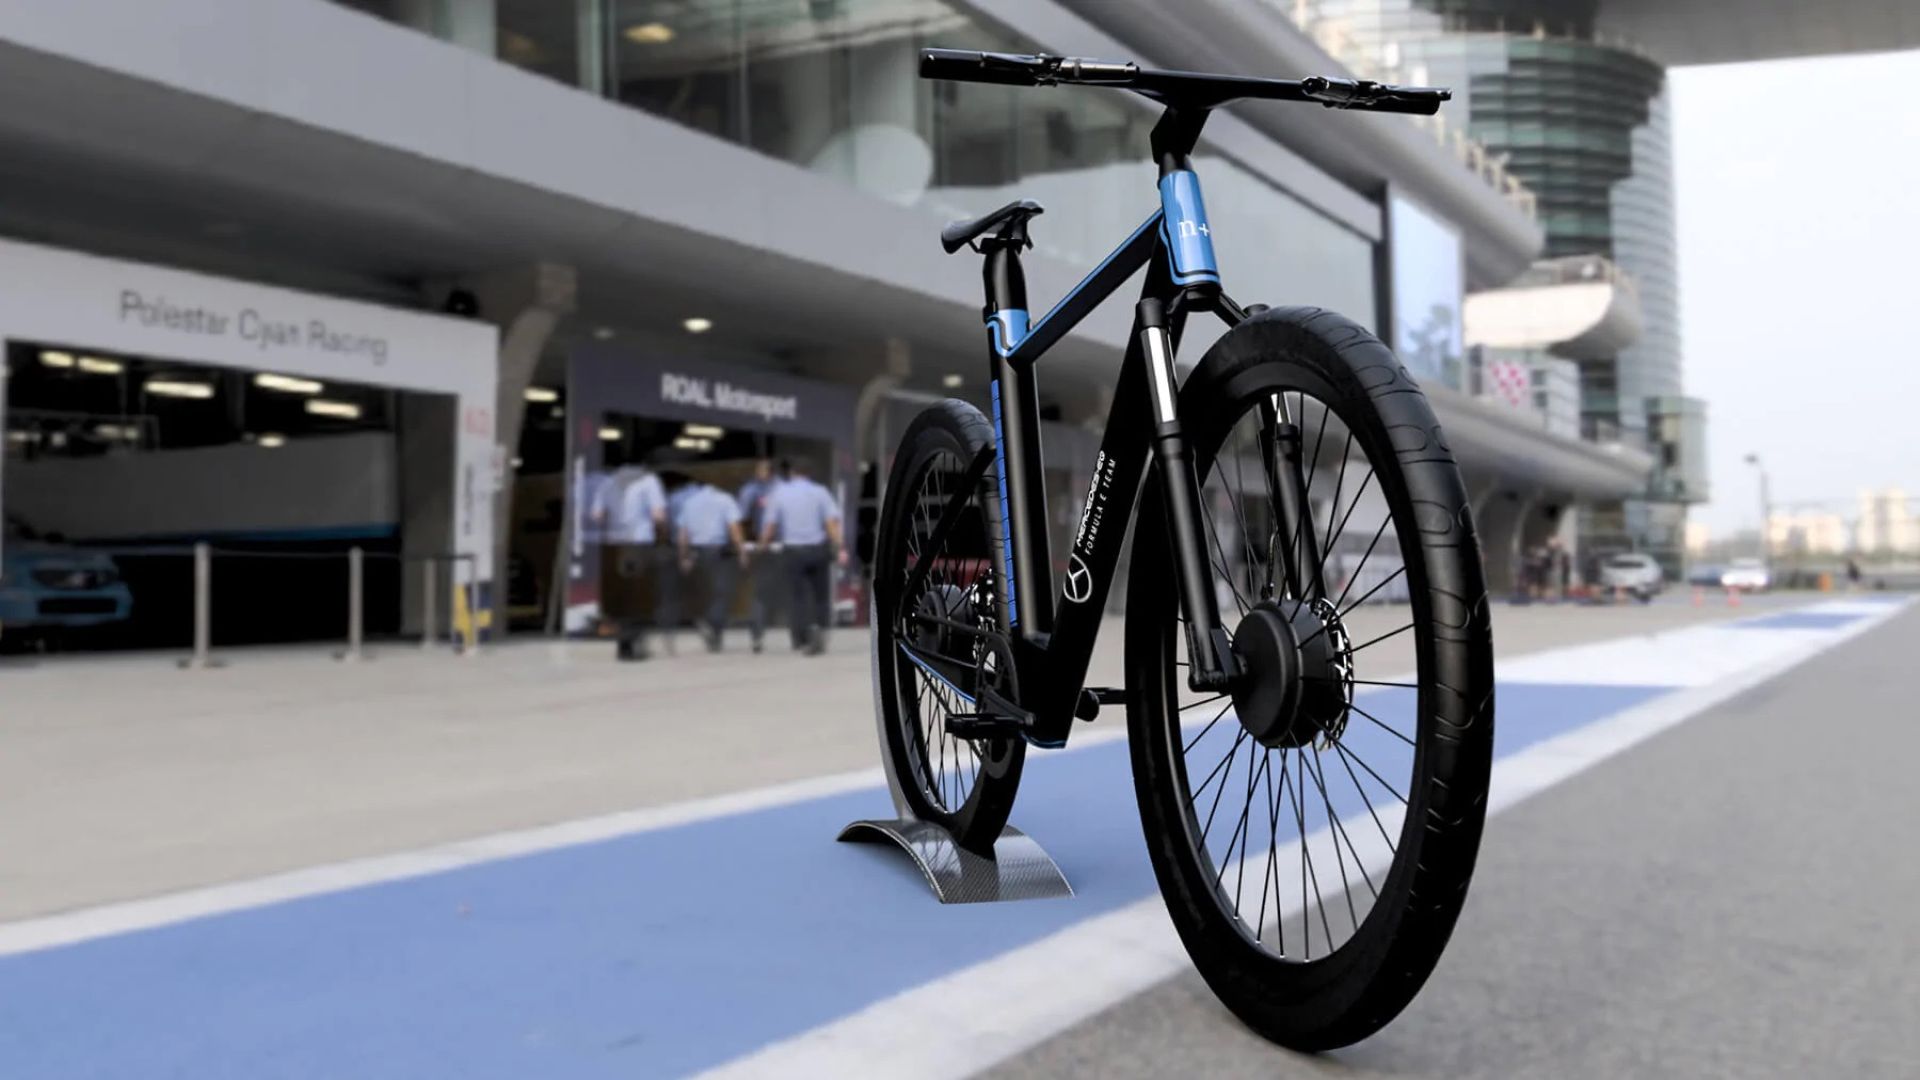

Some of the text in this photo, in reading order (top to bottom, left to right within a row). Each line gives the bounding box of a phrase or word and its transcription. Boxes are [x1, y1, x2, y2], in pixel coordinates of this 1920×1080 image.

[119, 288, 388, 367] Polestar Cyan Racing
[661, 372, 797, 424] ROAL Motorsport
[1085, 506, 1103, 555] FORMULA
[1103, 459, 1116, 487] TEAM
